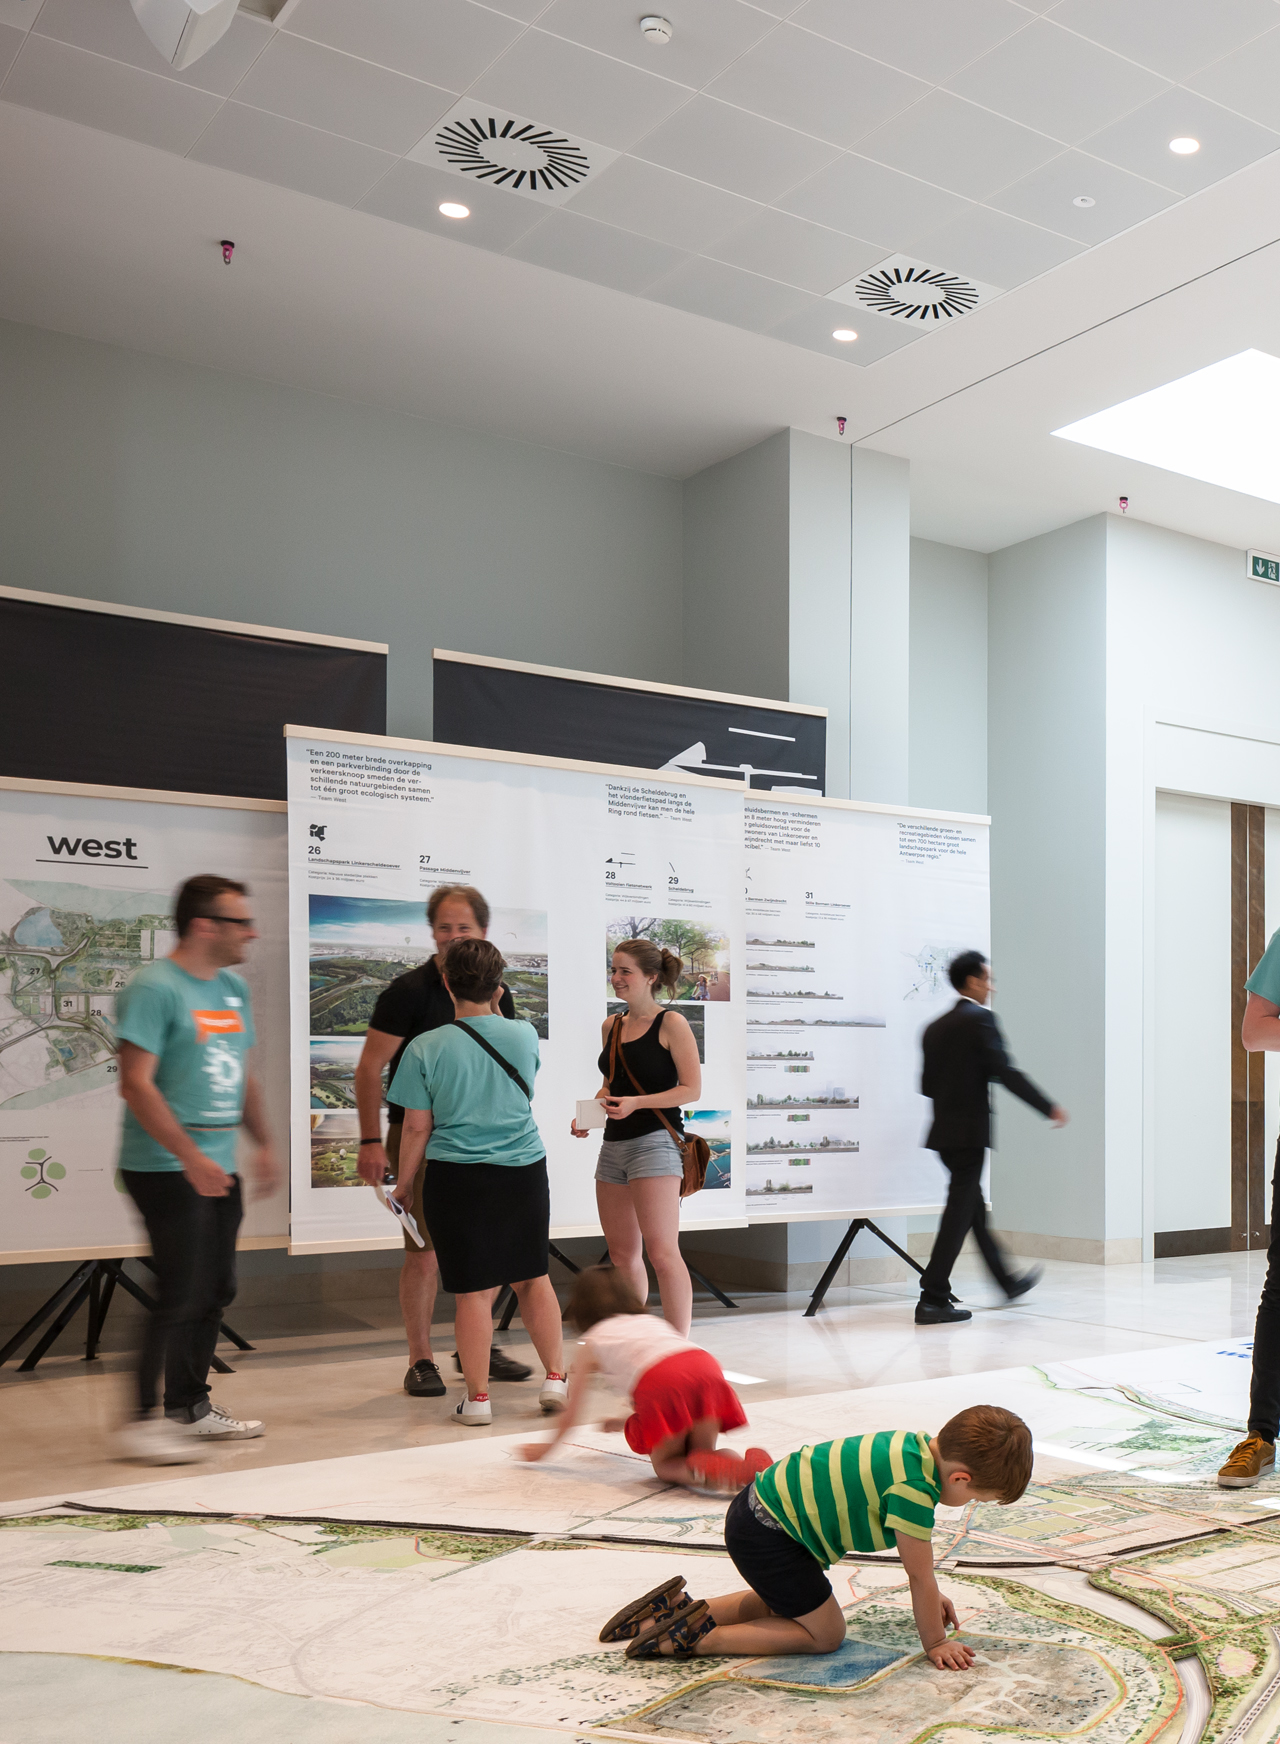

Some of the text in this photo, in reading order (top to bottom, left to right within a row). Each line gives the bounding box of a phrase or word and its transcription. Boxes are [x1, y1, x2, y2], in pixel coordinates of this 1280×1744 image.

[337, 762, 391, 774] parkverbinding
[388, 759, 432, 770] overkapping
[310, 768, 365, 779] verkeersknoop
[310, 776, 347, 785] schillende
[350, 781, 406, 792] natuurgebieden
[361, 790, 398, 800] ecologisch
[641, 788, 678, 798] Scheldebrug
[620, 794, 666, 804] vlonderfietspad
[608, 800, 646, 809] Middenvijver
[47, 836, 138, 860] west
[308, 846, 321, 855] 26
[420, 855, 430, 864] 27
